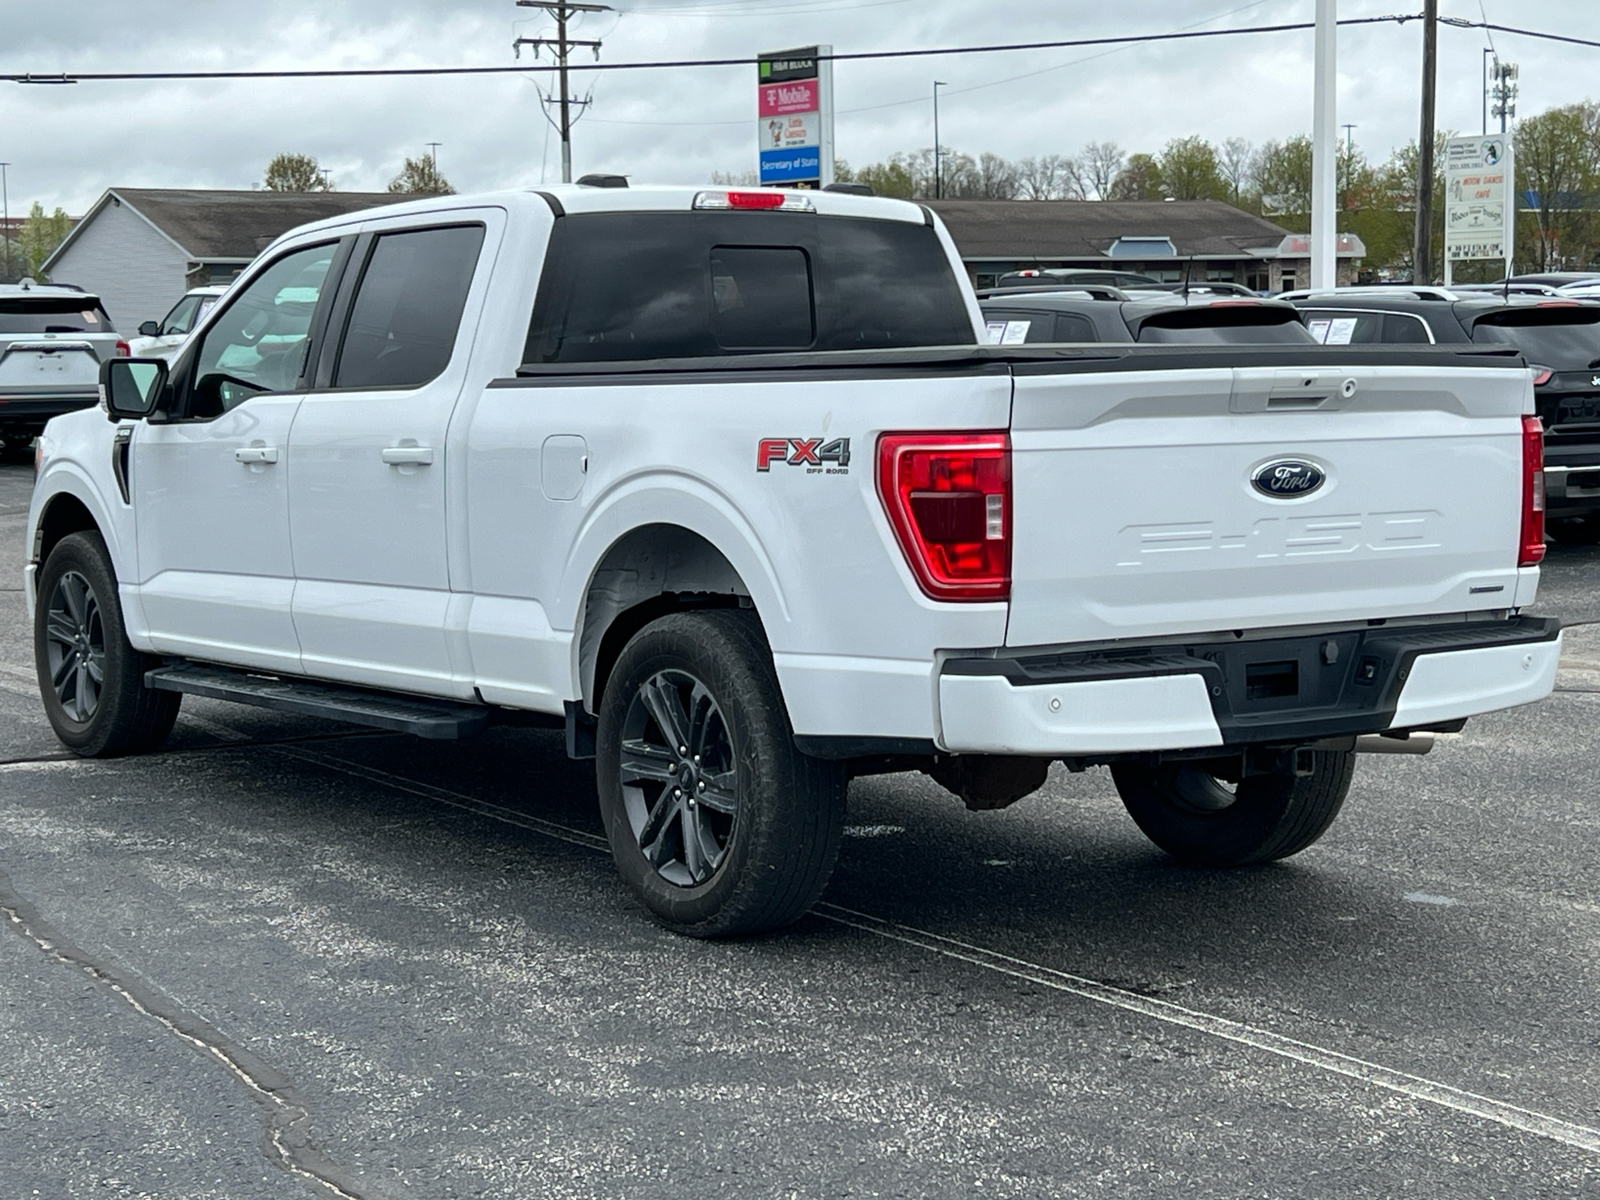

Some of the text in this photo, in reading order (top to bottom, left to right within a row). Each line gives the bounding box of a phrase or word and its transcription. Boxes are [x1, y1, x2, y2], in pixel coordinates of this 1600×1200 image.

[778, 86, 811, 105] Mobile
[761, 157, 819, 171] Secretary of State
[1462, 175, 1503, 185] MOON DANCE
[757, 437, 851, 473] FX4
[1270, 466, 1312, 490] Ford
[1115, 509, 1446, 567] F-150
